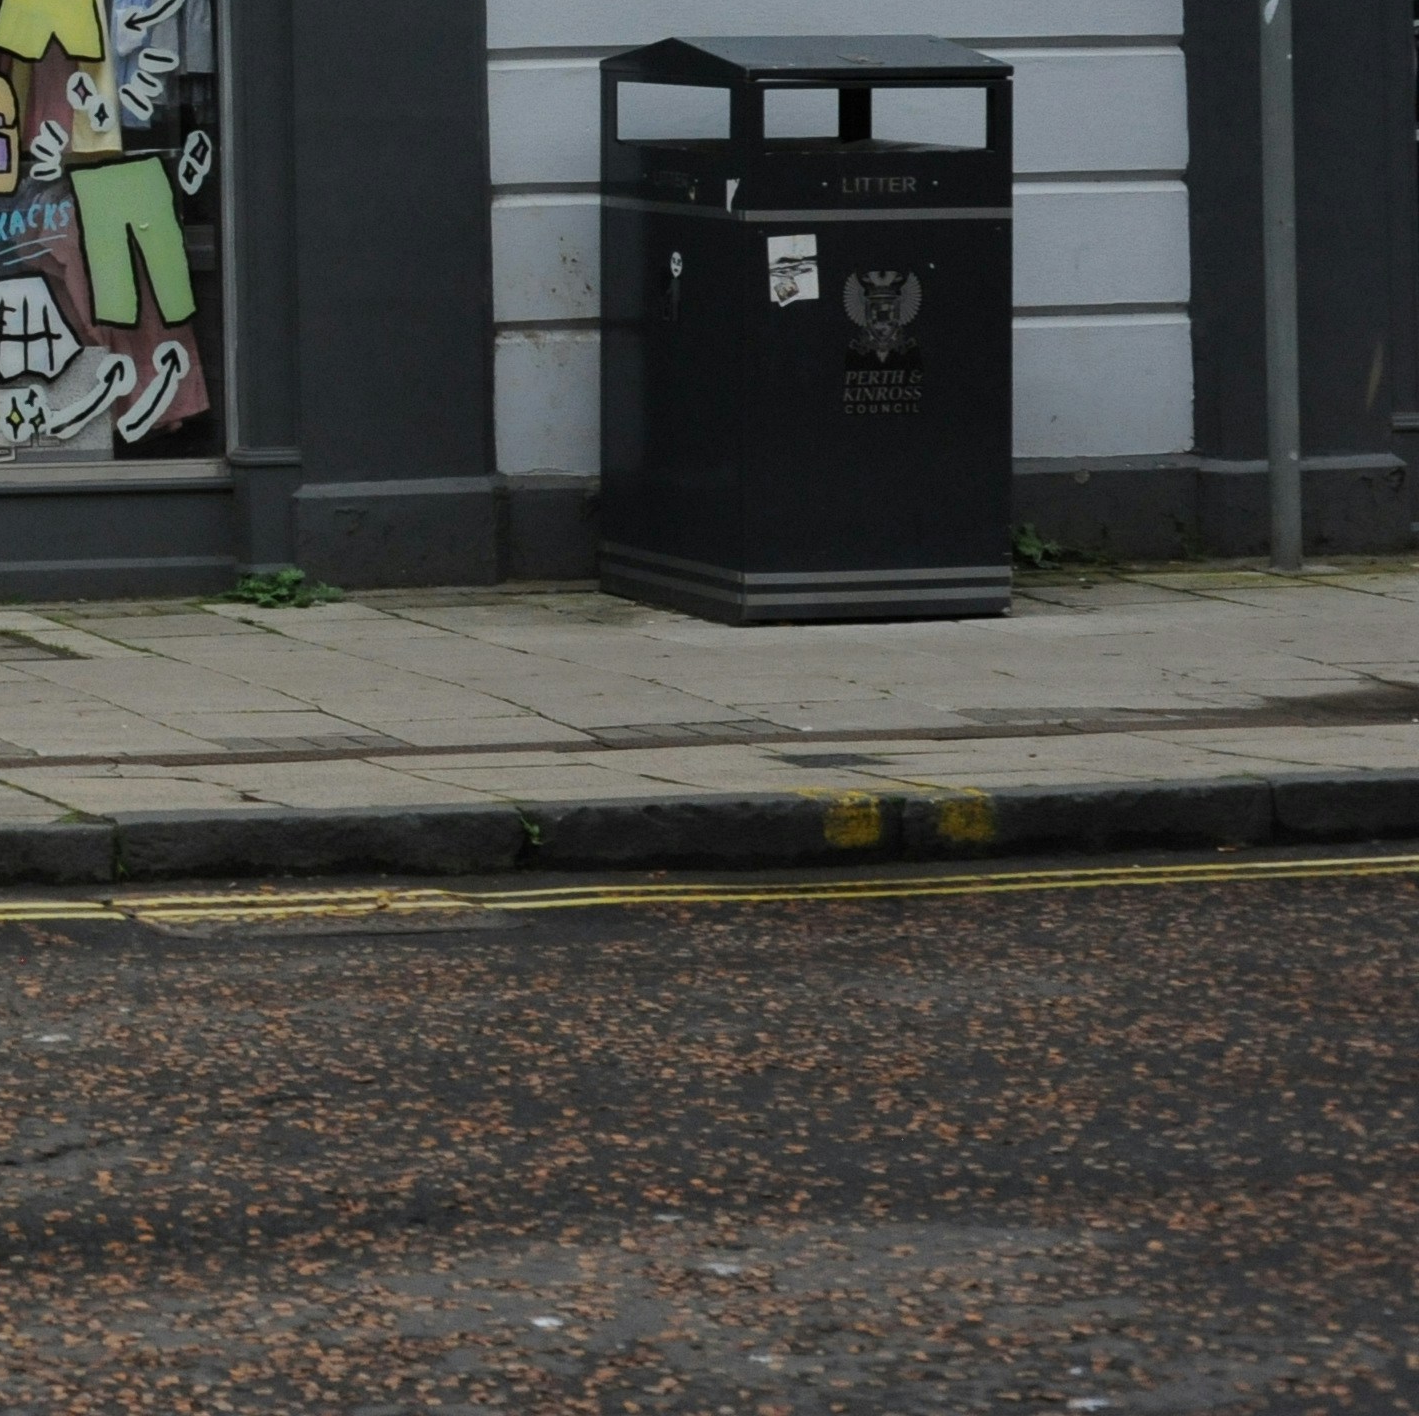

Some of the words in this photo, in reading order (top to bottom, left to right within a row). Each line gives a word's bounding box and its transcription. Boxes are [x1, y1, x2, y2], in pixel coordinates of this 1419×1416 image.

[842, 176, 917, 194] LITTER
[845, 369, 906, 385] PERTH
[909, 369, 923, 384] &
[843, 386, 923, 402] KINROSS
[844, 403, 920, 414] COUNCIL
